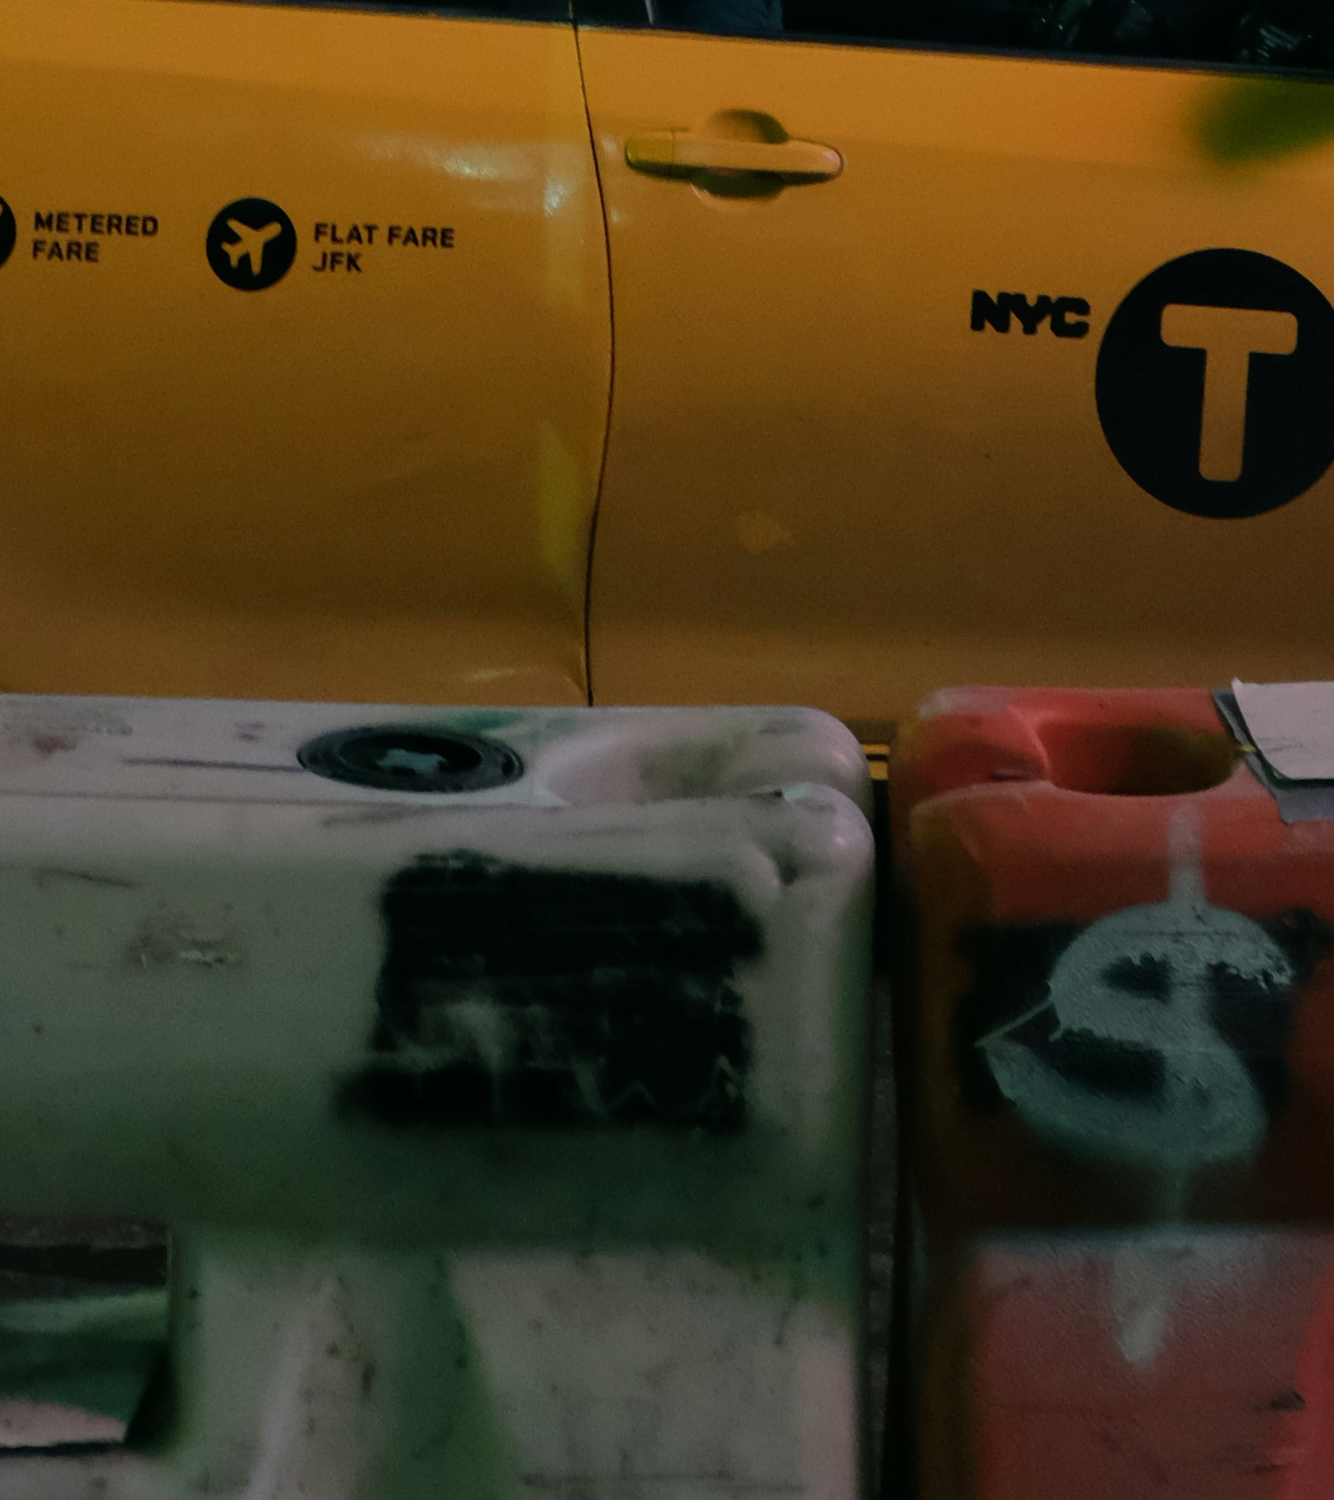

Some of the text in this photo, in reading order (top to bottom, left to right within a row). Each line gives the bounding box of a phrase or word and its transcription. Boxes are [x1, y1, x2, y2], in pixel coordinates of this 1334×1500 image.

[34, 211, 159, 237] METERED
[314, 222, 455, 249] FLAT FARE
[32, 238, 100, 263] FARE
[312, 251, 363, 273] JFK
[970, 290, 1299, 483] NYC T
